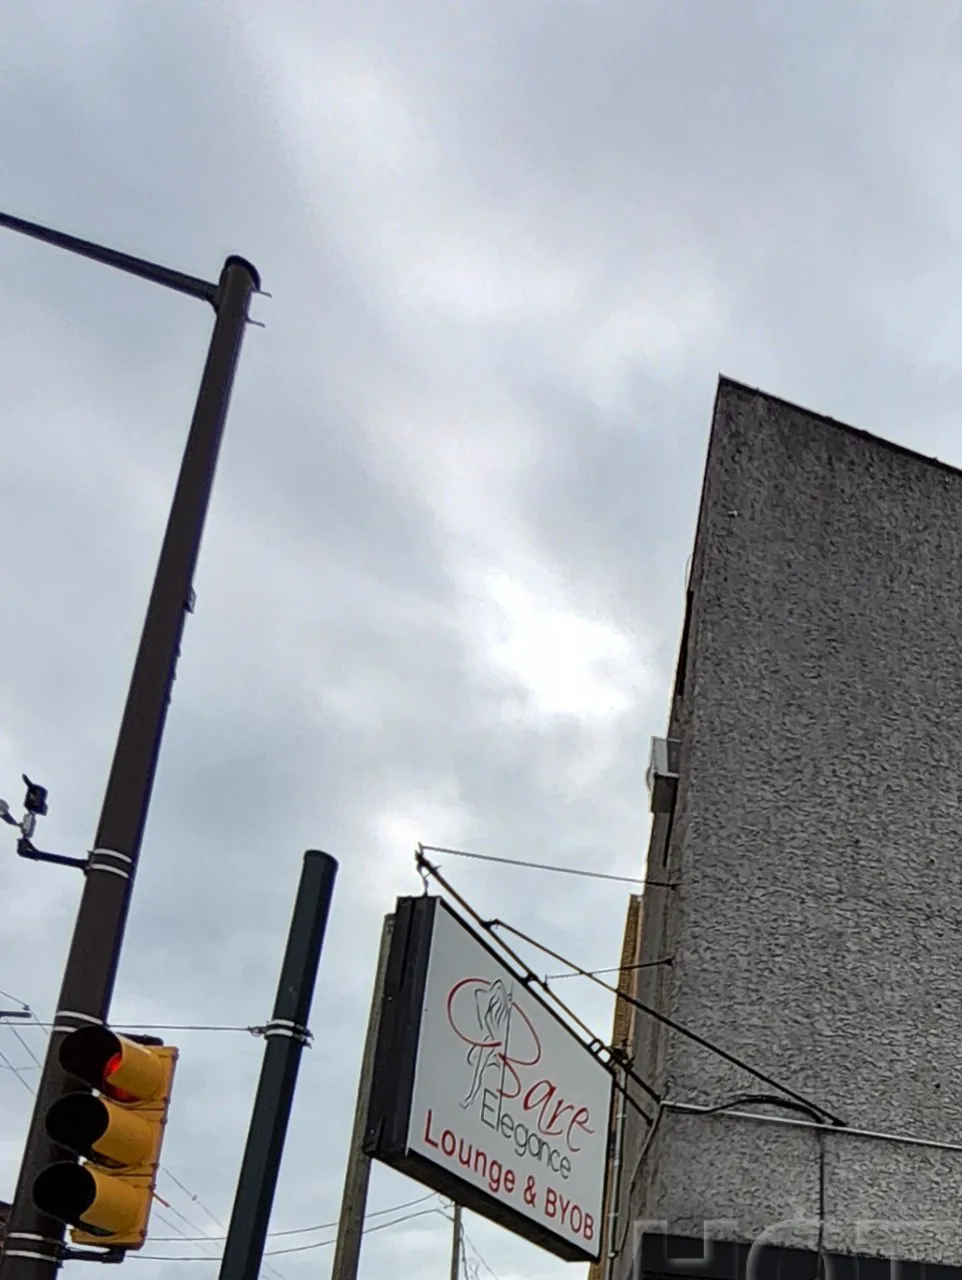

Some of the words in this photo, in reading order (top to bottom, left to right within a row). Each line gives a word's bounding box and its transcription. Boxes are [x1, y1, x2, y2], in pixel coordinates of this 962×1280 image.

[447, 977, 596, 1152] Bare
[423, 1108, 516, 1193] Lounge
[523, 1174, 537, 1208] &
[544, 1186, 595, 1241] BYOB
[480, 1087, 573, 1180] Elegance
